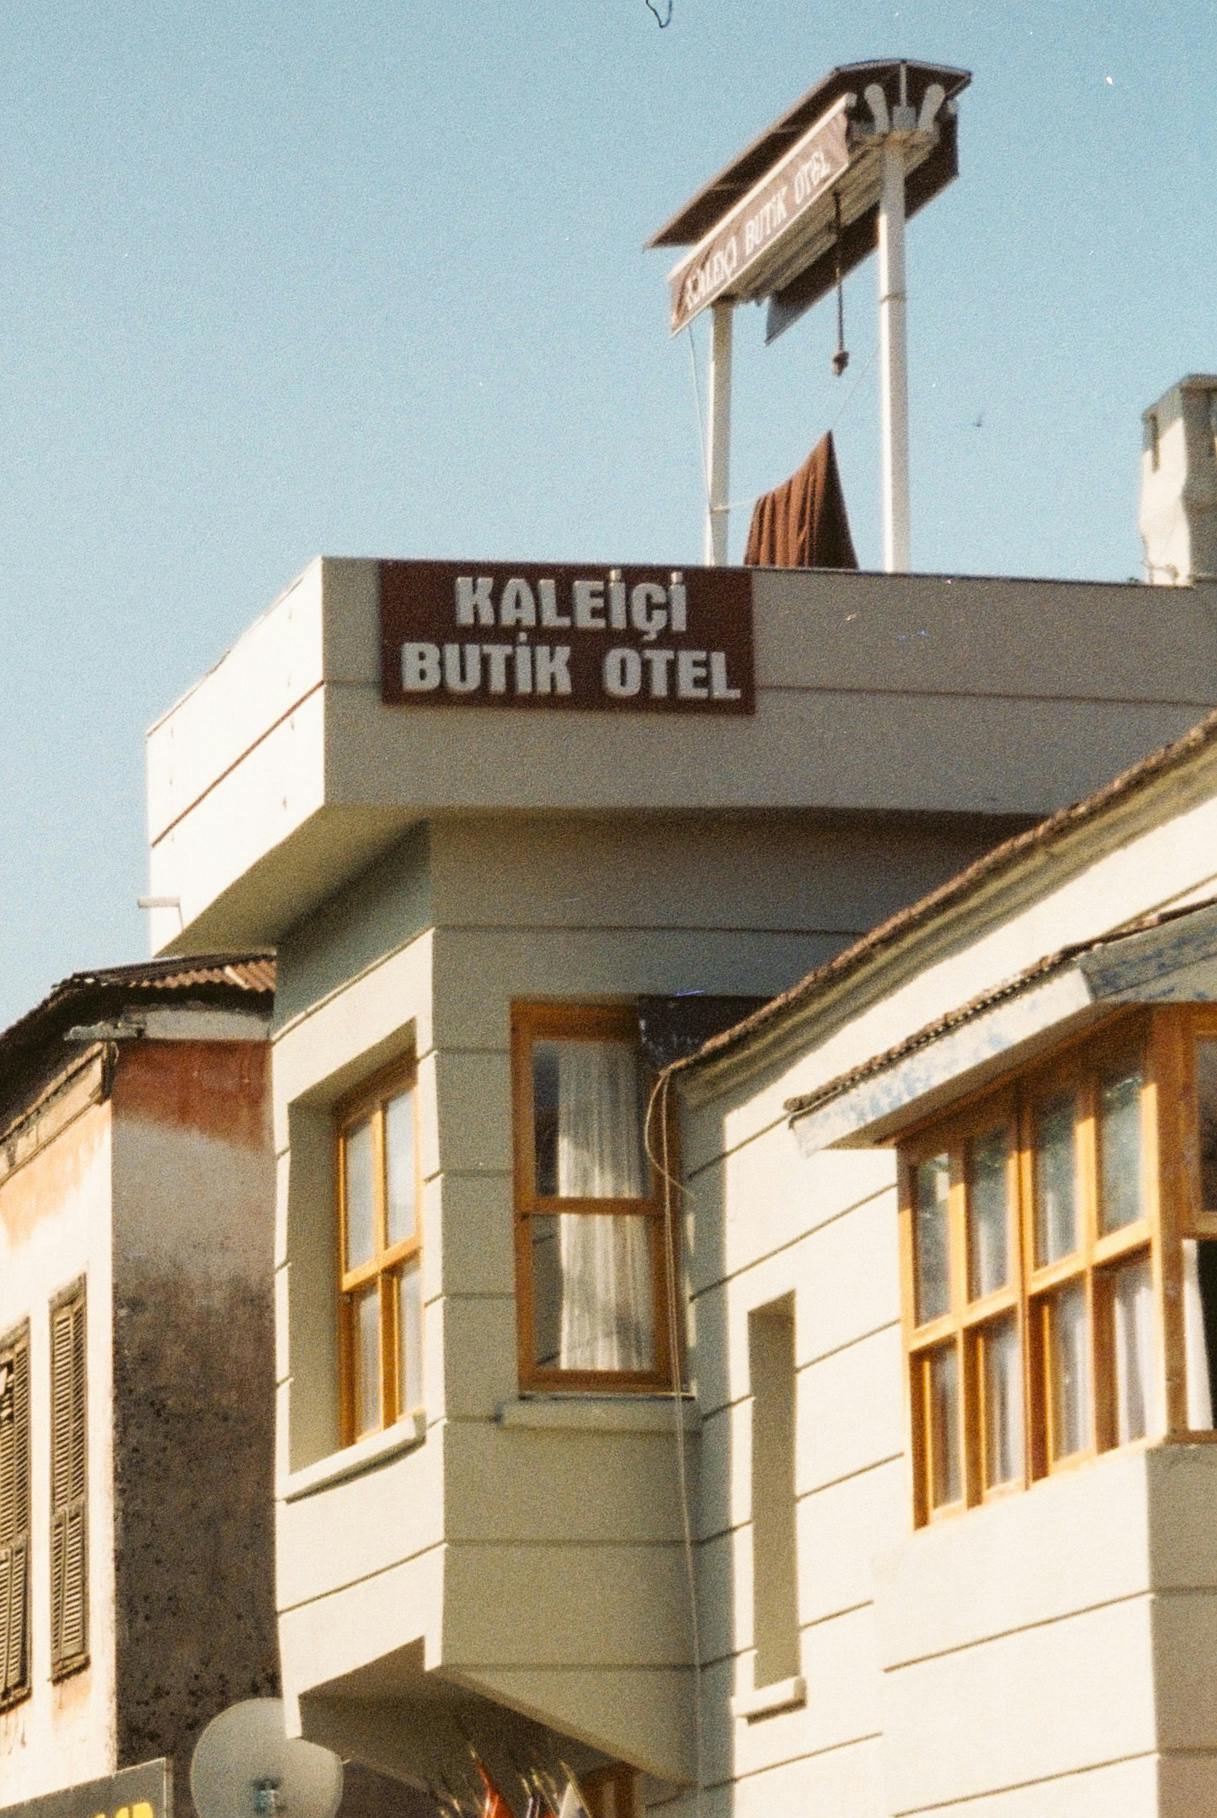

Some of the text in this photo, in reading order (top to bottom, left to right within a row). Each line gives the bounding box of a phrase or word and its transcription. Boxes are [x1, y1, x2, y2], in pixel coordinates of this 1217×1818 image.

[455, 568, 688, 641] KALEİÇİ
[400, 632, 742, 701] BUTİK OTEL
